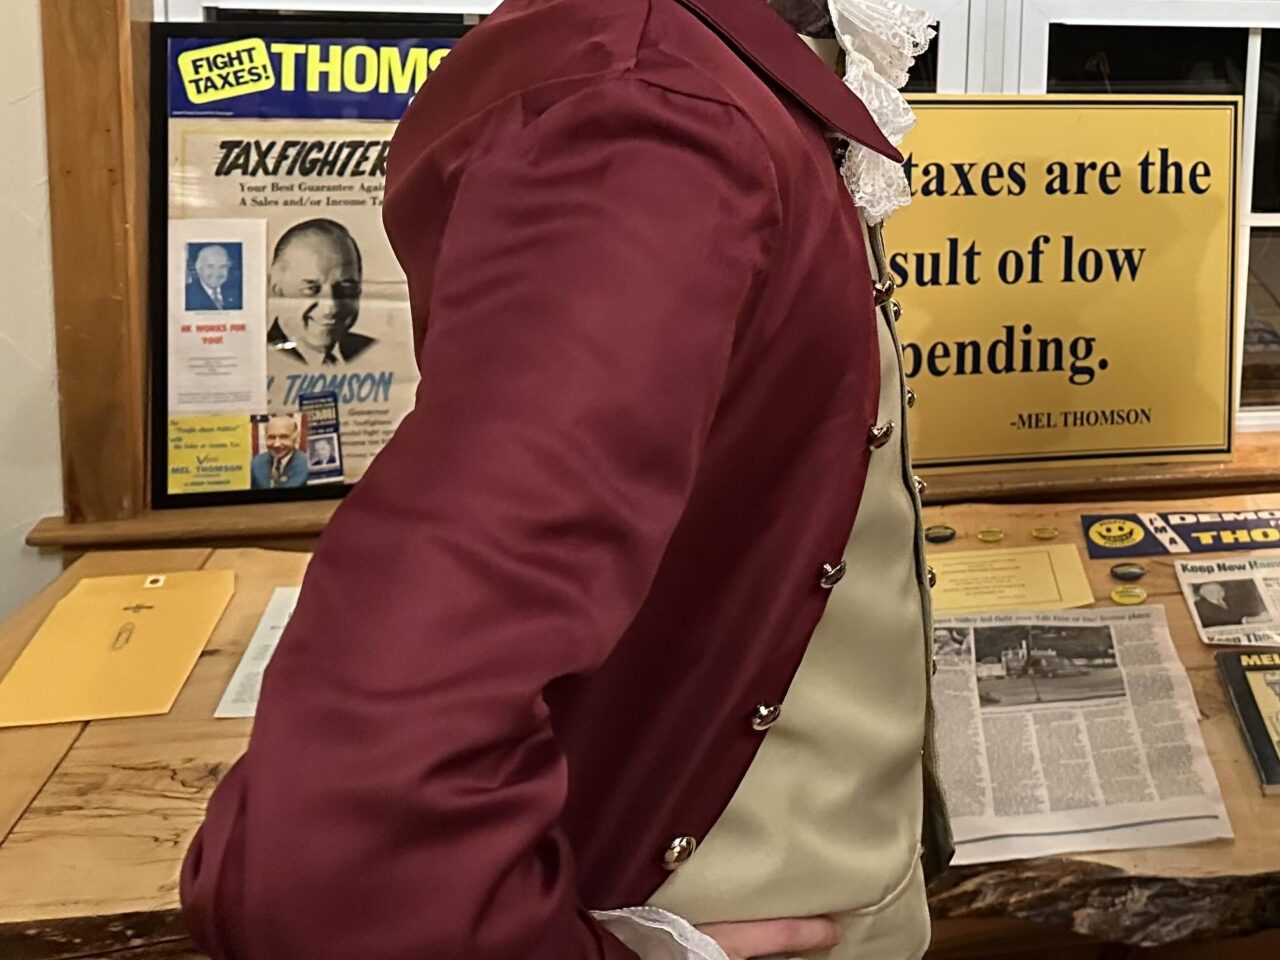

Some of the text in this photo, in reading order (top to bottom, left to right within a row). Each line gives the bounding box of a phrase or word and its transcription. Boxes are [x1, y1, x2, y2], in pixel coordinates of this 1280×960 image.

[191, 47, 257, 75] FIGHT
[188, 65, 271, 96] TAXES!
[901, 148, 1212, 196] taxes are the
[239, 182, 267, 192] Your
[271, 182, 294, 192] Best
[298, 182, 354, 192] Guarantee
[239, 197, 247, 206] A
[251, 196, 279, 207] Sales
[283, 196, 322, 207] and/or
[326, 196, 366, 206] Income
[888, 235, 1147, 288] sult of low
[195, 324, 227, 333] WORKS
[230, 323, 246, 332] FOR
[283, 372, 394, 406] THOMSON
[1010, 408, 1152, 430] -MEL THOMSON
[1181, 562, 1215, 574] Keep
[1217, 561, 1246, 572] New
